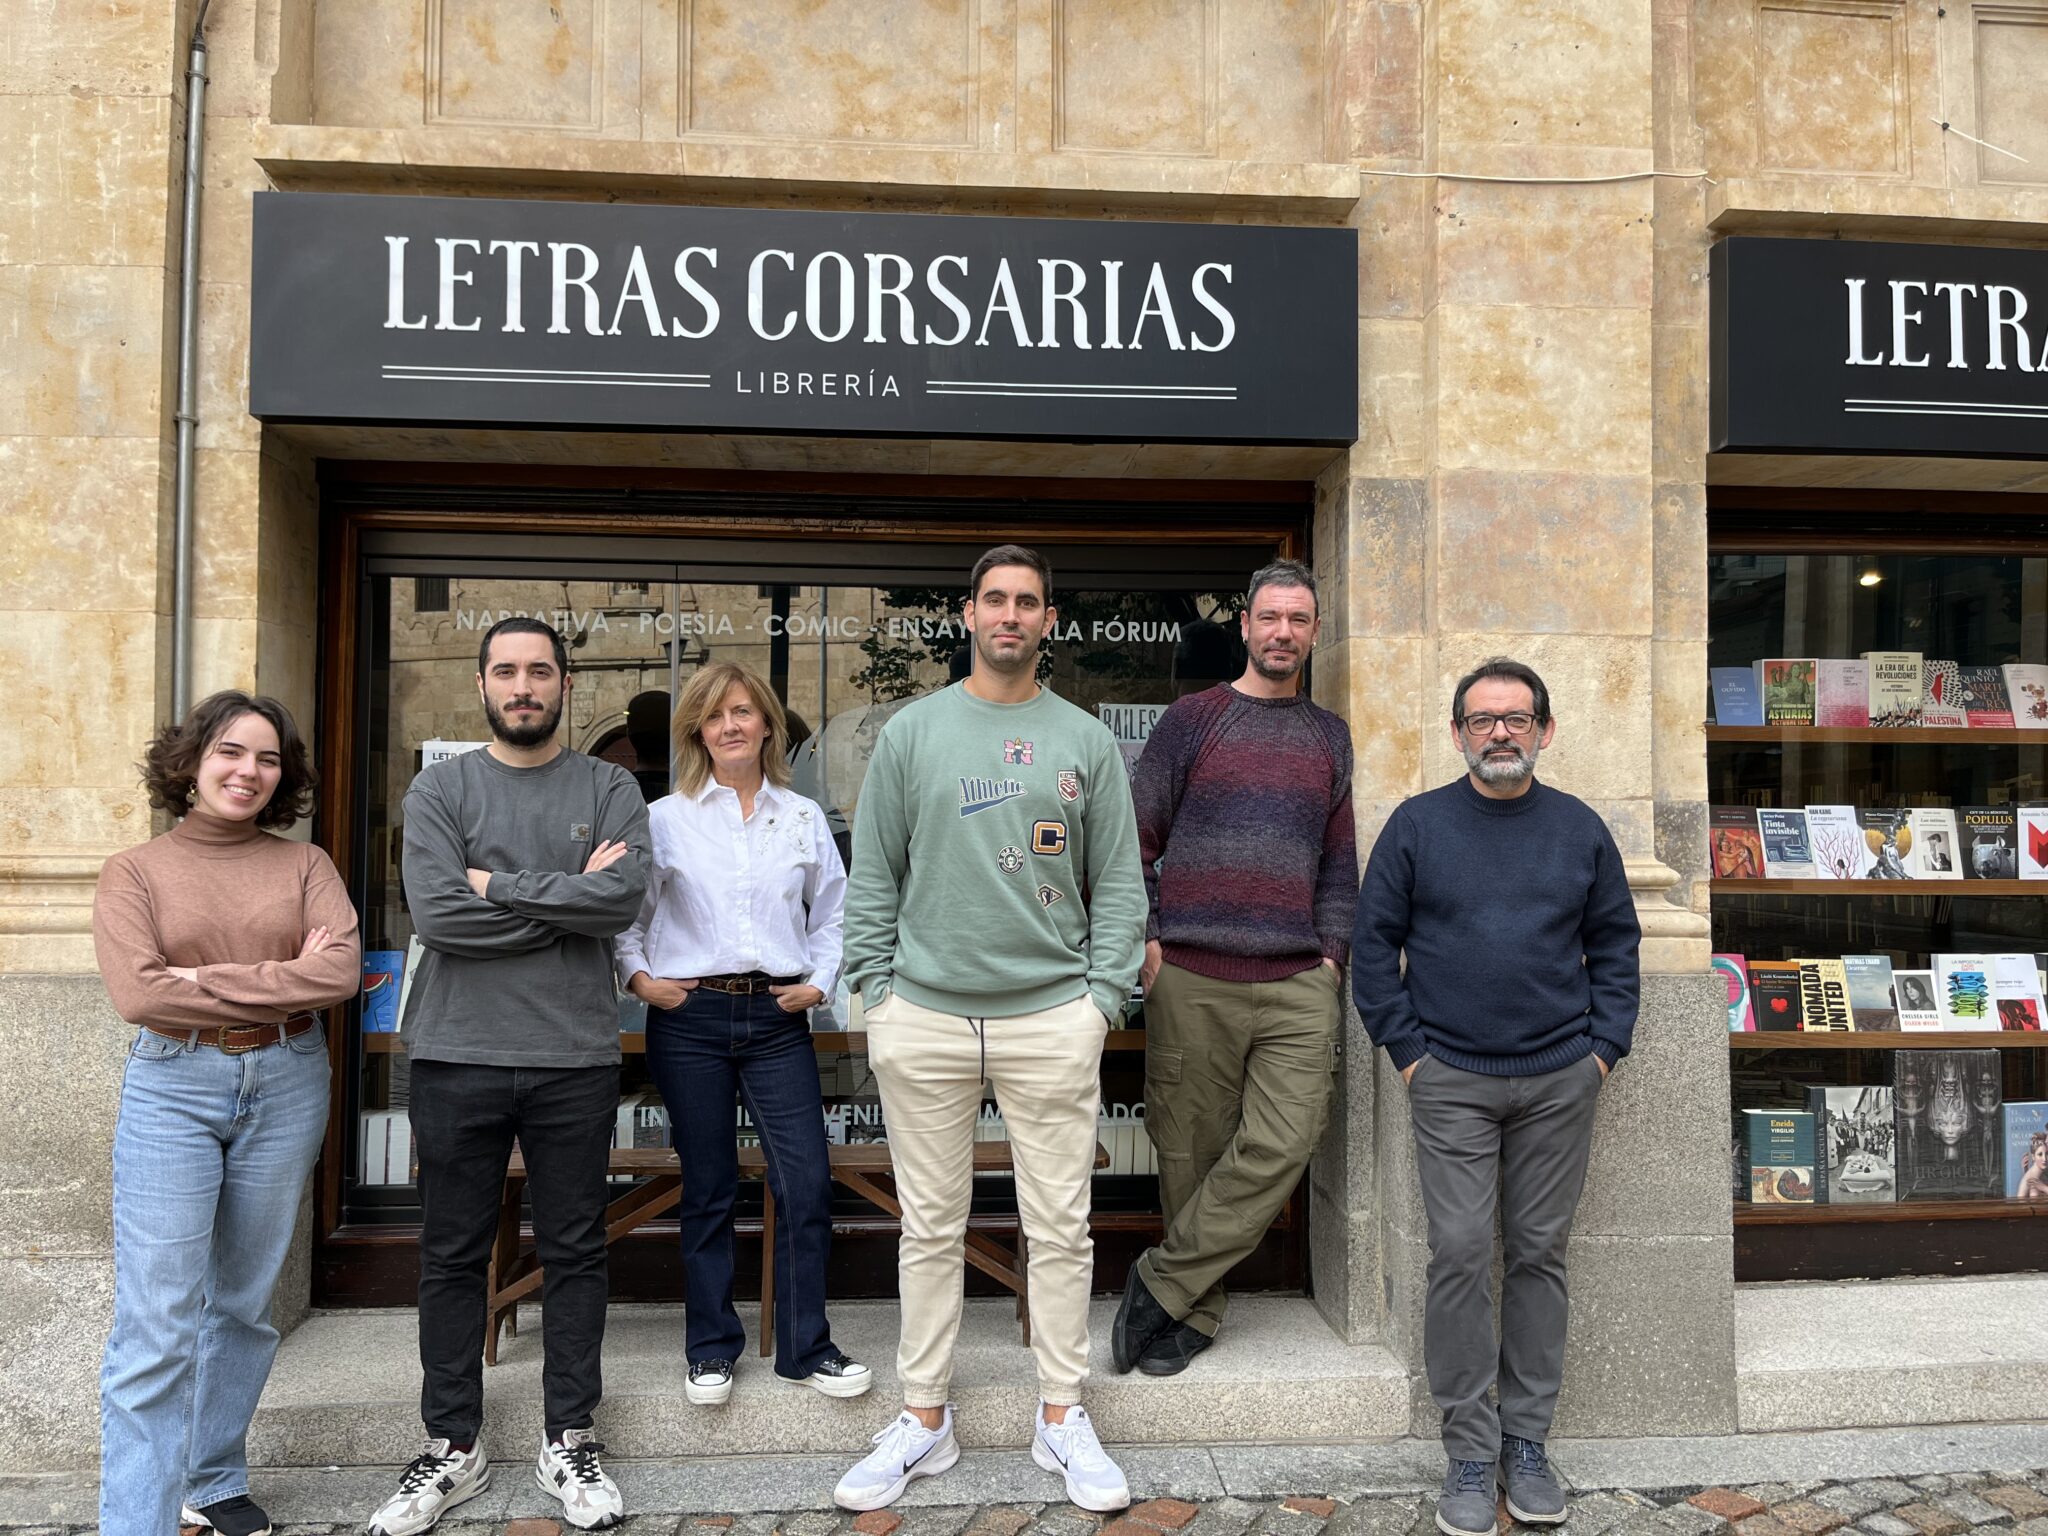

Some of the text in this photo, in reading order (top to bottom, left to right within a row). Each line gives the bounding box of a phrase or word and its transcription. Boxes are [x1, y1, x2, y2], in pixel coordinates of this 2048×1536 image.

[383, 236, 1237, 353] LETRAS CORSARIAS
[1844, 278, 2048, 373] LETR
[736, 369, 901, 398] LIBRERÍA
[639, 609, 735, 635] POESÍA
[763, 609, 861, 638] CÓMIC
[888, 616, 968, 640] ENSAY
[1092, 614, 1183, 643] FÓRUM
[1875, 664, 1917, 672] LA ERA DE LAS
[1875, 671, 1917, 680] REVOLUCIONES
[1960, 674, 1995, 684] QUINTO
[1986, 699, 2007, 709] REY
[1768, 709, 1813, 720] ASTURIAS
[1924, 715, 1963, 726] PALESTINA
[1103, 708, 1157, 740] BAILES
[959, 776, 1026, 804] Athletic
[1763, 819, 1786, 828] Tinta
[1965, 815, 2013, 825] POPULUS
[1031, 819, 1068, 857] C
[1765, 827, 1800, 836] invisible
[1799, 963, 1829, 1027] NOMADA
[1823, 981, 1850, 1031] UNITED
[1770, 1119, 1795, 1128] Eneida
[435, 1474, 456, 1497] N
